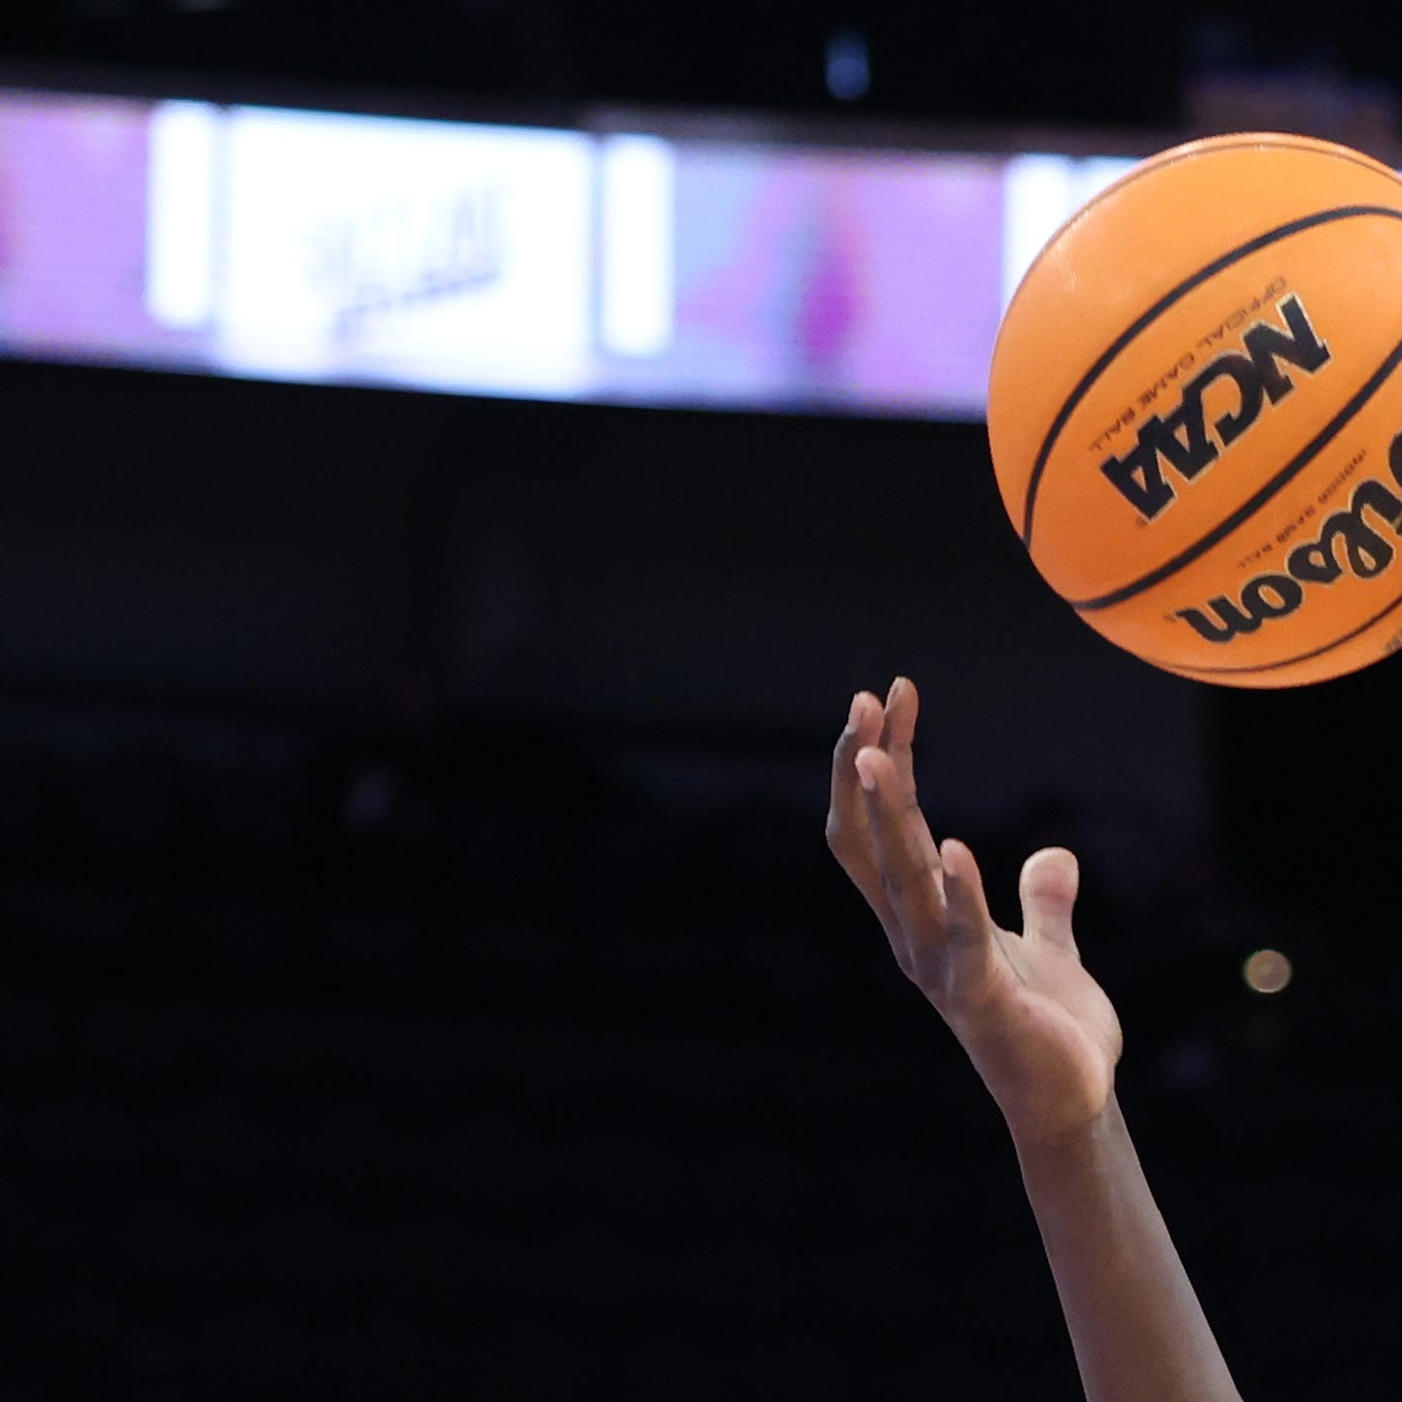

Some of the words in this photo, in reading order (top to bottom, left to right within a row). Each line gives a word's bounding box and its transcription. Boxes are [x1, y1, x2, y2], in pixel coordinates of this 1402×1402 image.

[1099, 291, 1332, 523] NCAA
[1138, 353, 1196, 407] GAME
[1088, 408, 1136, 451] BALL
